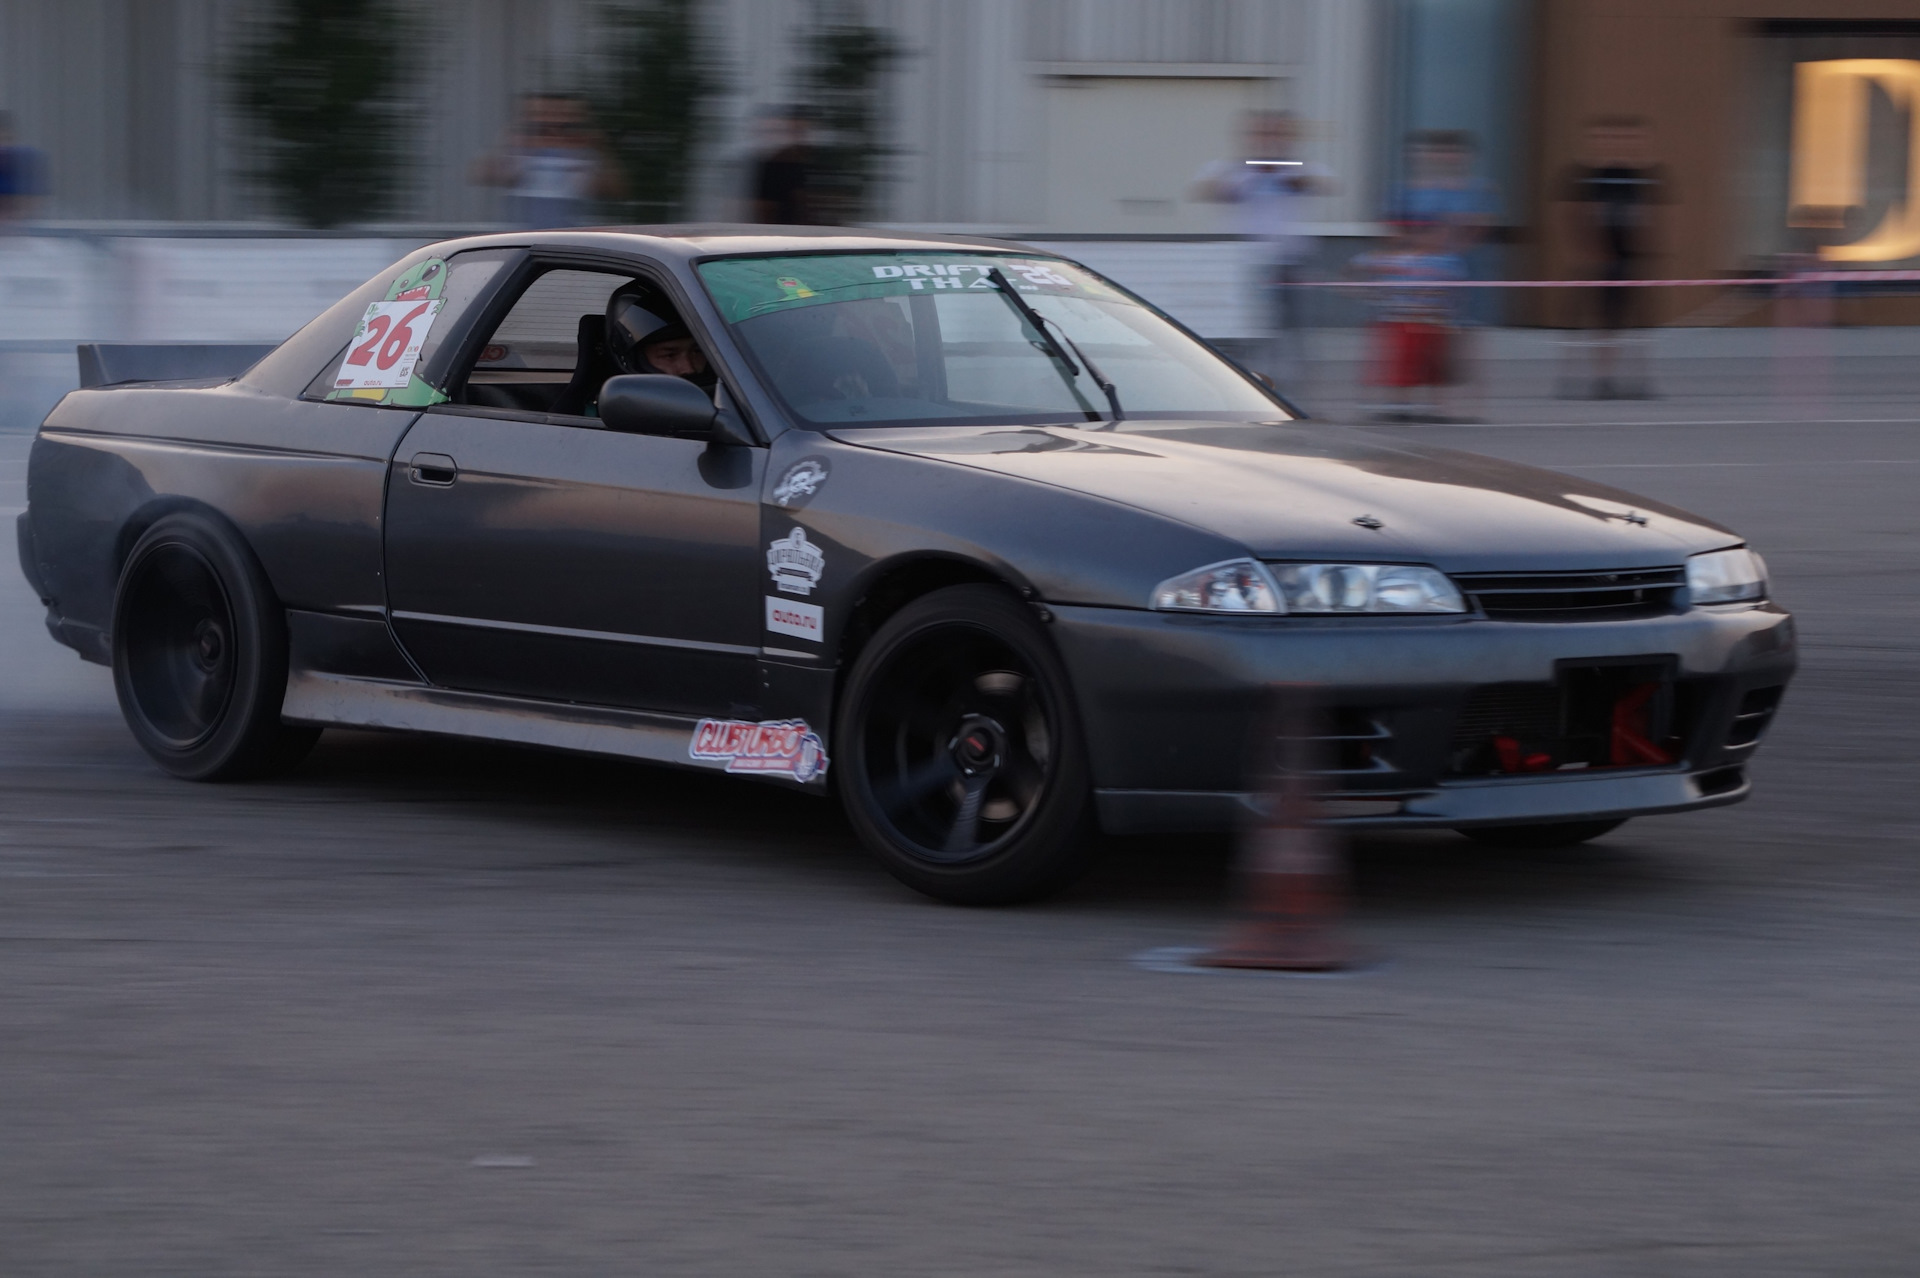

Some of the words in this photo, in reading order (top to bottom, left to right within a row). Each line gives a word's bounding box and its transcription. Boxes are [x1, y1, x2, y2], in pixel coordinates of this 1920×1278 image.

[872, 264, 993, 279] DRIFT
[346, 301, 431, 371] 26
[772, 609, 817, 629] auto.ru
